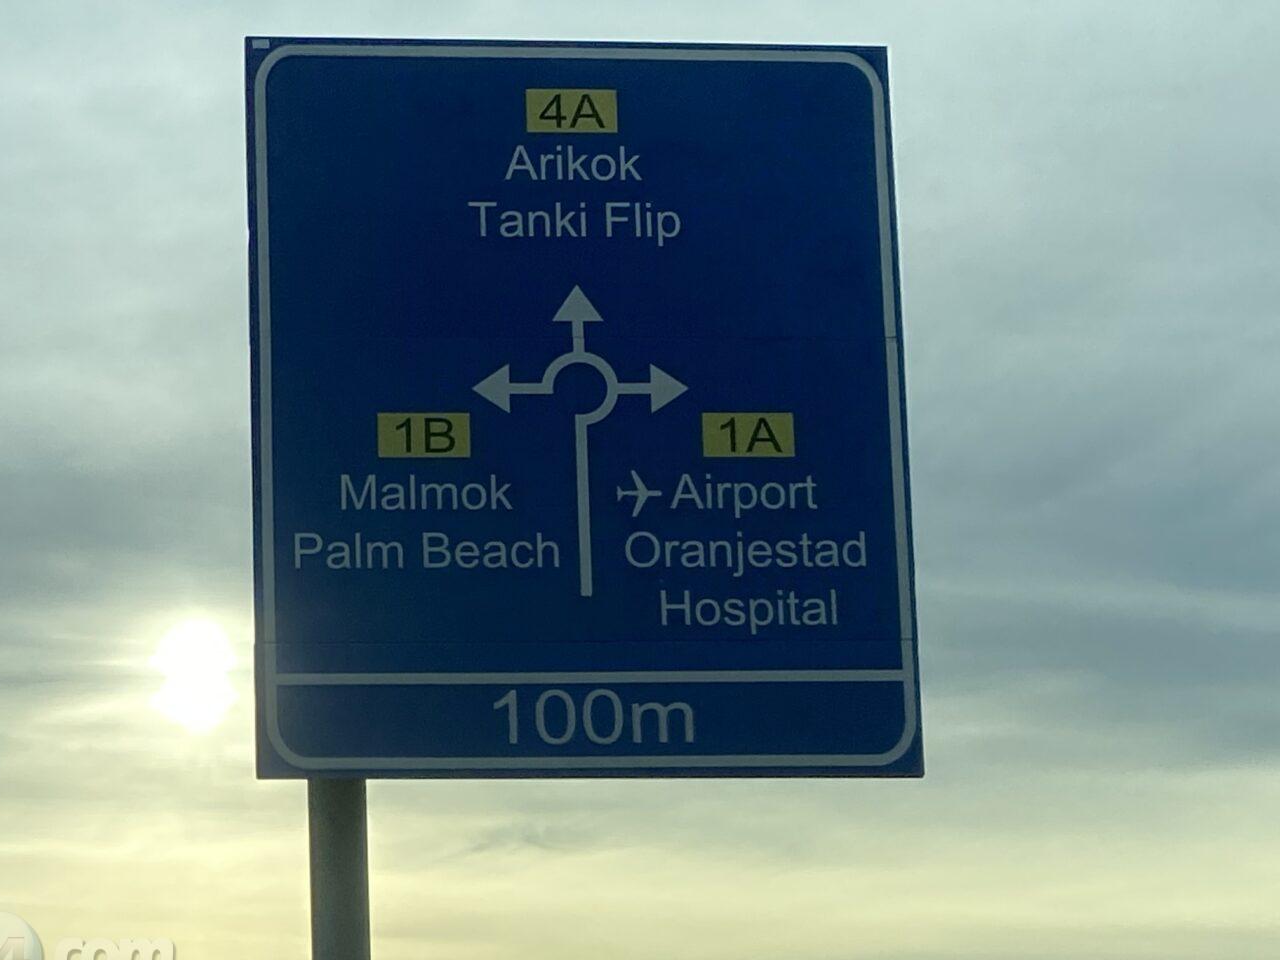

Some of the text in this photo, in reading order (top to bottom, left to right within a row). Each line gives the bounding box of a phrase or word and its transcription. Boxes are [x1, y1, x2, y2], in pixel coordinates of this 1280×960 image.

[539, 94, 605, 128] 4A
[506, 145, 641, 180] Arikok
[468, 202, 680, 246] Tanki Flip
[396, 418, 455, 452] 1B
[720, 418, 782, 452] 1A
[341, 474, 512, 510] Malmok
[671, 474, 817, 518] Airport
[295, 532, 559, 569] Palm Beach
[625, 531, 866, 577] Oranjestad
[661, 589, 837, 634] Hospital
[494, 689, 694, 744] 100m
